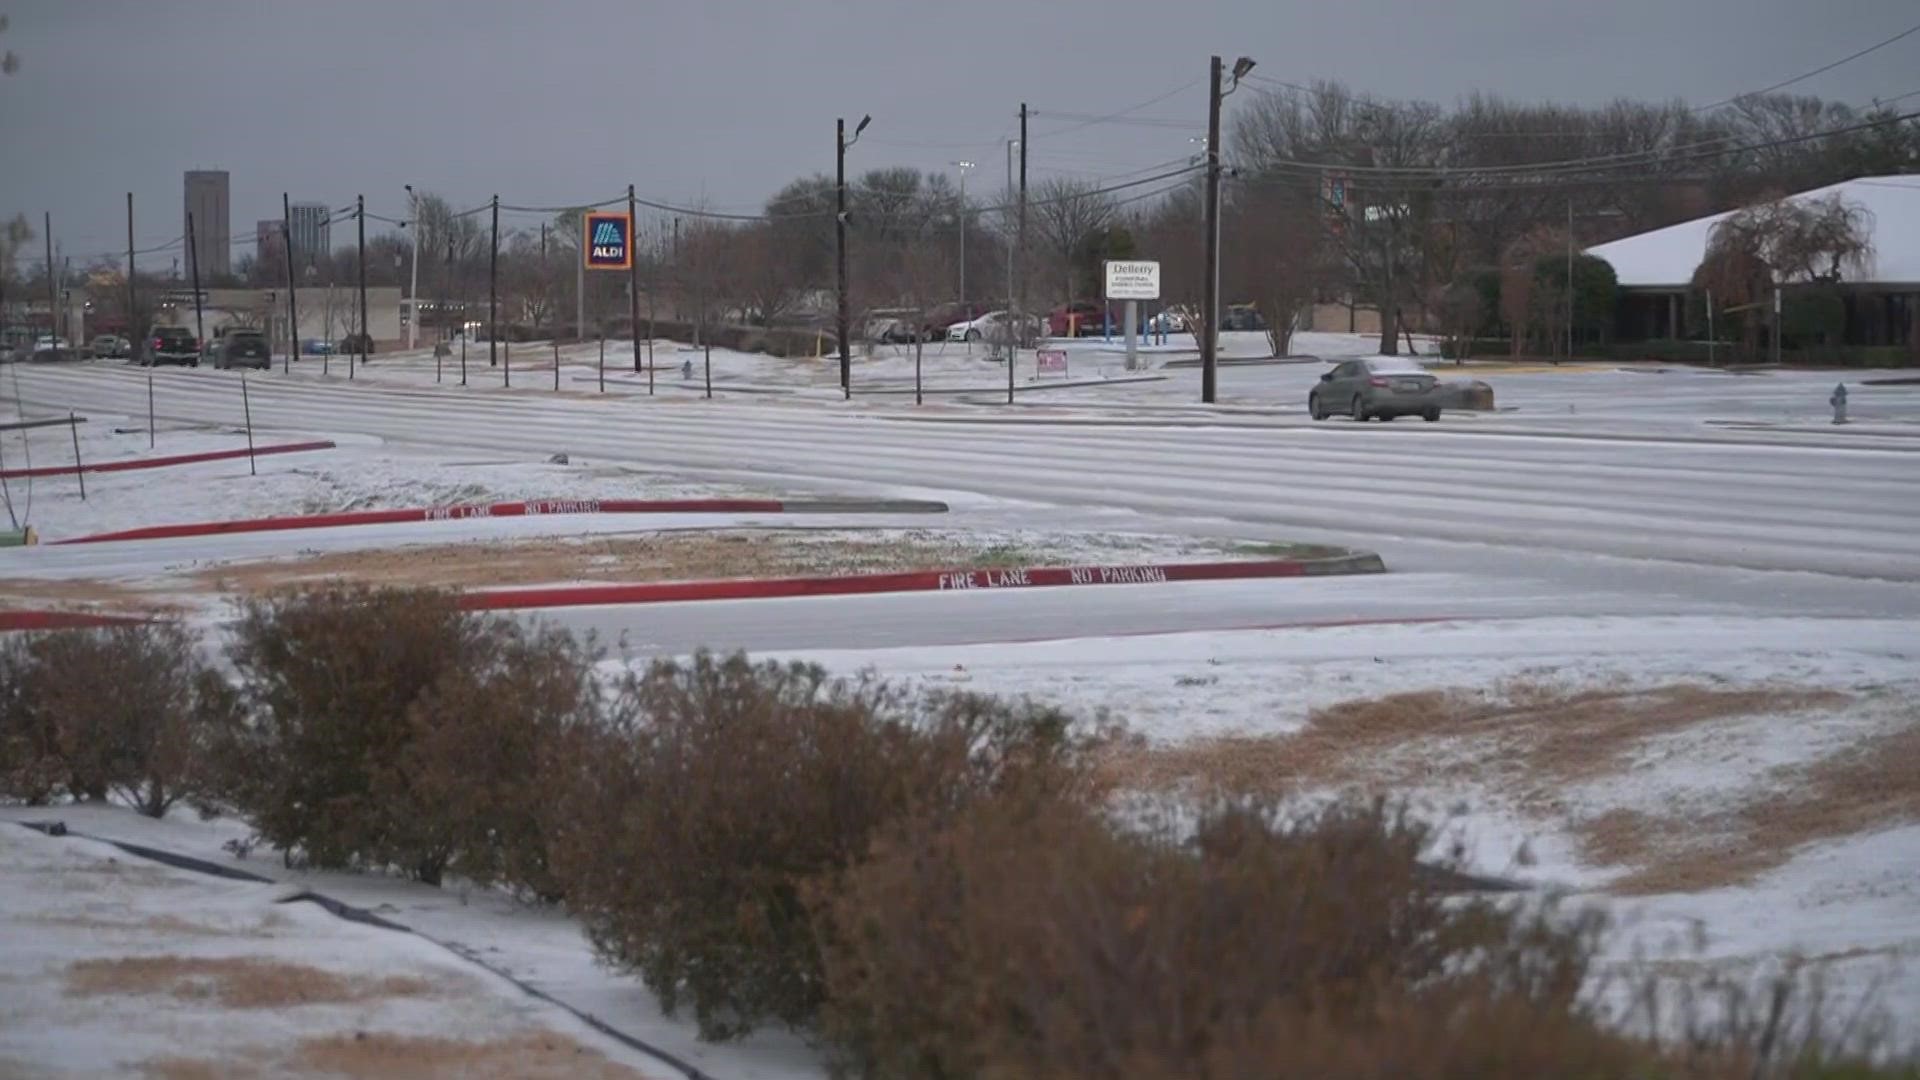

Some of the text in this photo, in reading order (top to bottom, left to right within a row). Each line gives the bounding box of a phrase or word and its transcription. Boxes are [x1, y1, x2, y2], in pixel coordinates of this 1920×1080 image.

[593, 246, 623, 257] ALDI
[939, 566, 1167, 590] FIRE LANE NO PARKING
